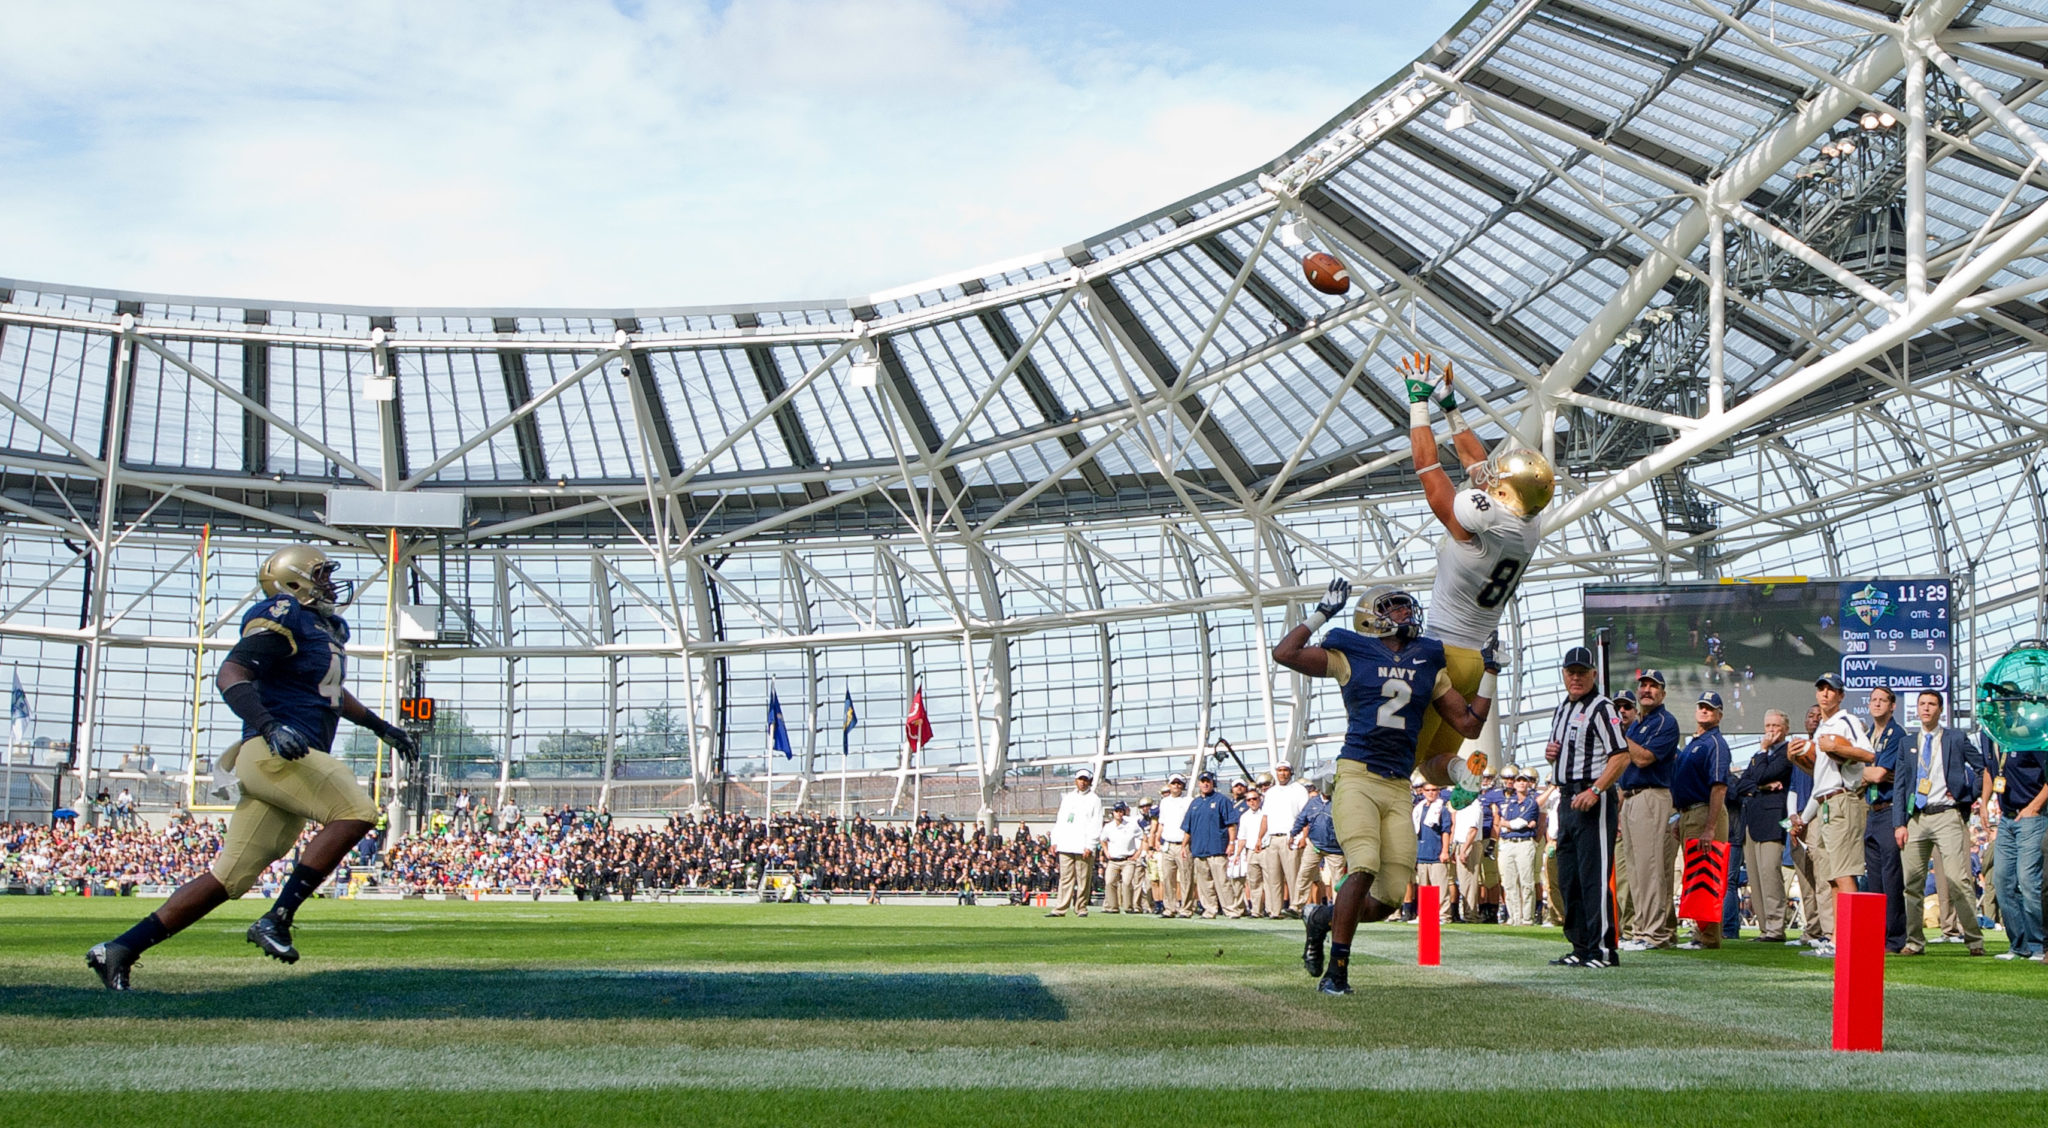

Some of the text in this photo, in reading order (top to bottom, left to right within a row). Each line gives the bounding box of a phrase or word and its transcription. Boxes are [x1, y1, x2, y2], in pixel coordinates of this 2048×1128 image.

[1898, 585, 1948, 602] 11:29
[1938, 607, 1946, 619] 2
[1843, 628, 1946, 640] Down To Go Ball On
[1846, 640, 1935, 652] 2ND 5 5
[1846, 658, 1942, 671] NAVY 0
[1377, 666, 1417, 681] NAVY
[1846, 674, 1944, 687] NOTRE DAME 13
[402, 698, 432, 720] 40
[1376, 678, 1413, 730] 2
